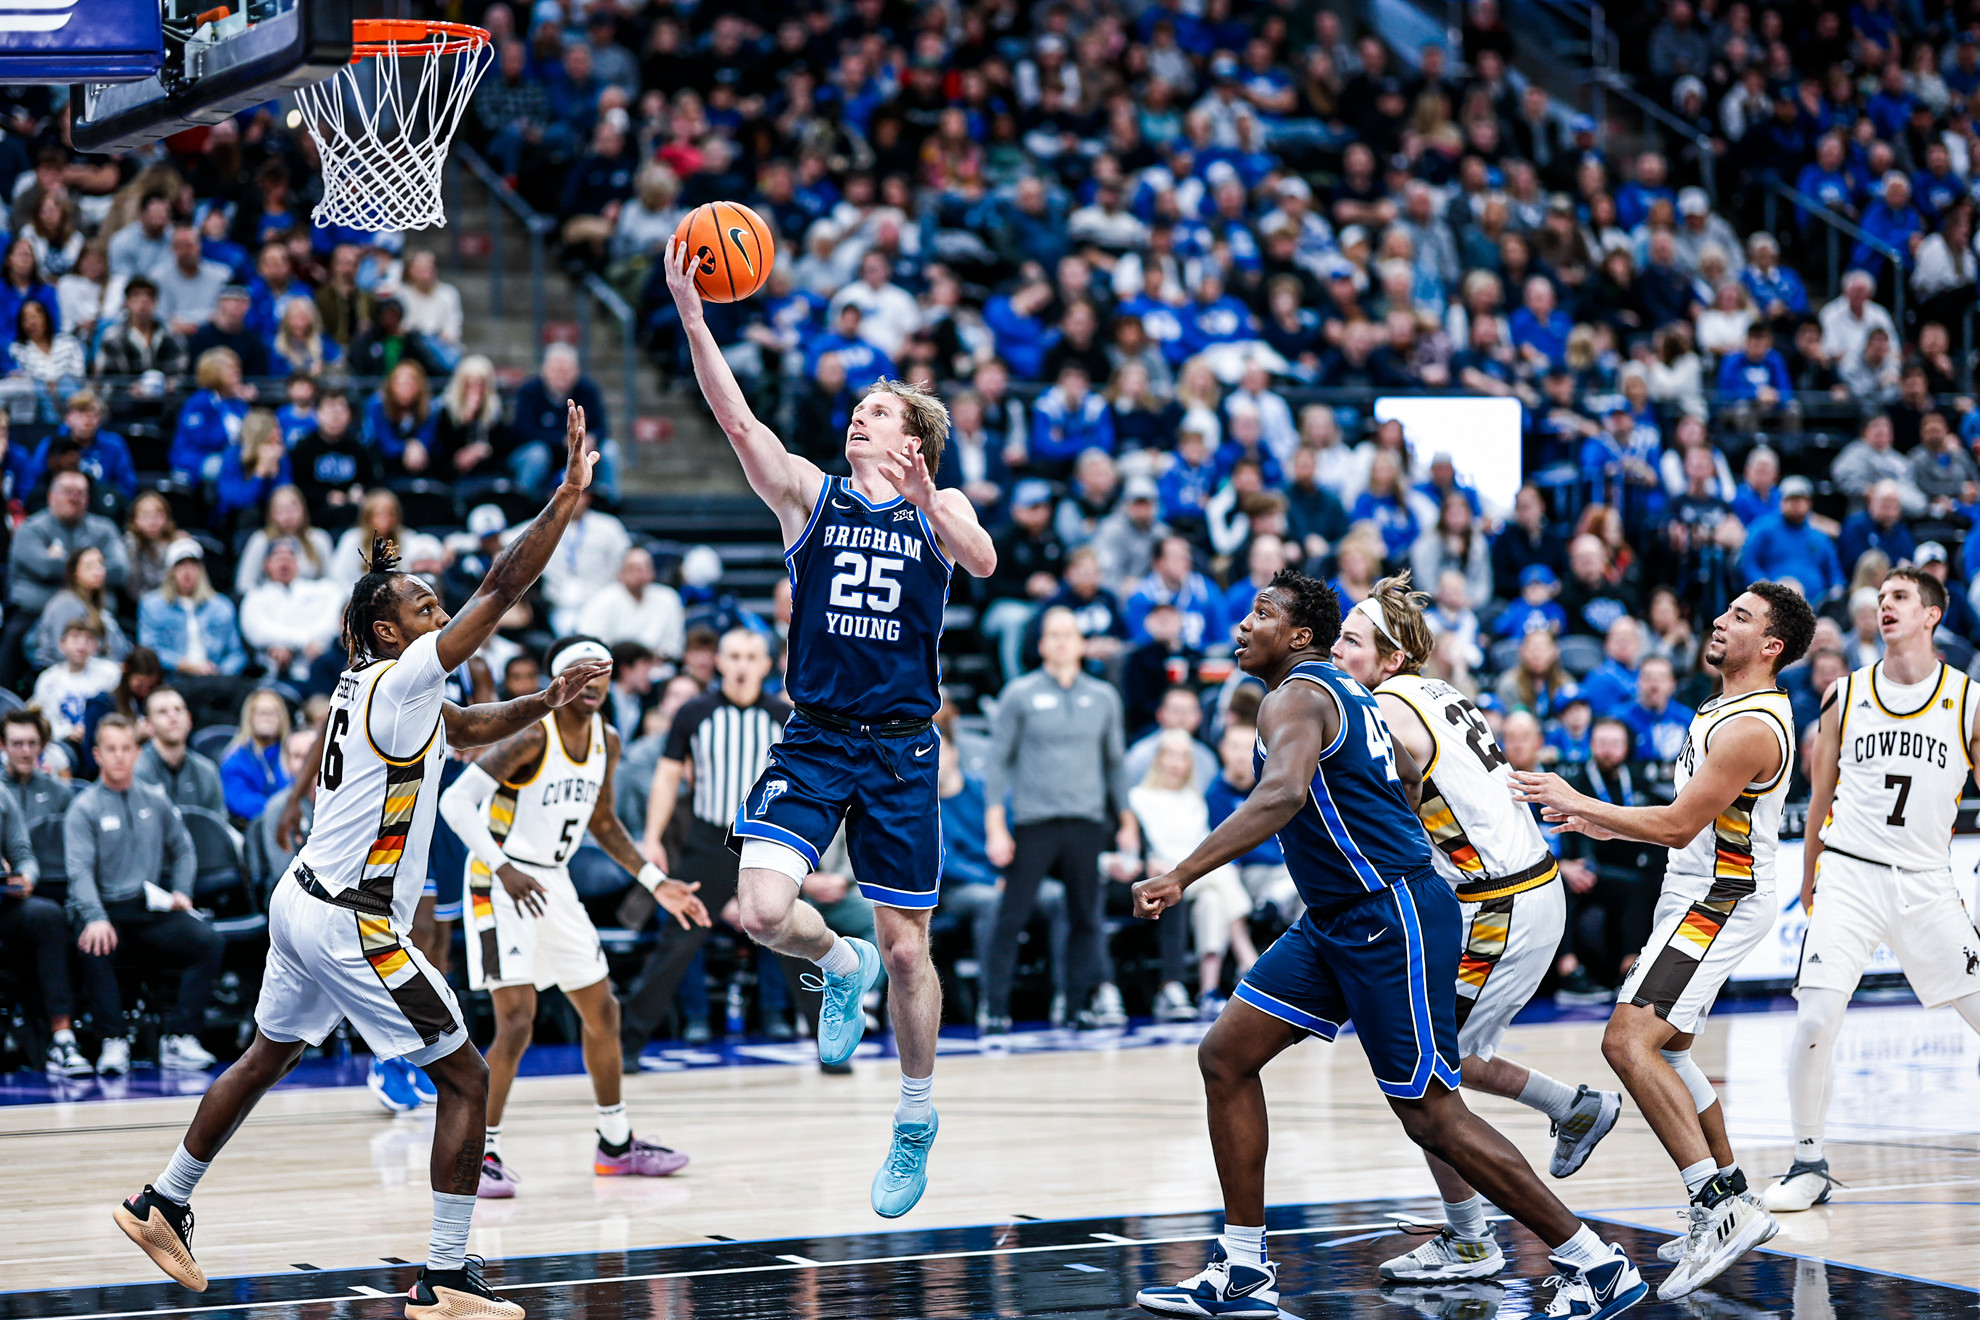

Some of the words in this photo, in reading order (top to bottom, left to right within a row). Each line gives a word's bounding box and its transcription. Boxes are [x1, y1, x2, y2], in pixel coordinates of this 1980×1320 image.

[823, 525, 923, 563] BRIGHAM
[829, 551, 904, 613] 25
[825, 610, 900, 642] YOUNG
[1855, 731, 1948, 769] COWBOYS
[1884, 774, 1912, 827] 7
[554, 818, 579, 862] 5
